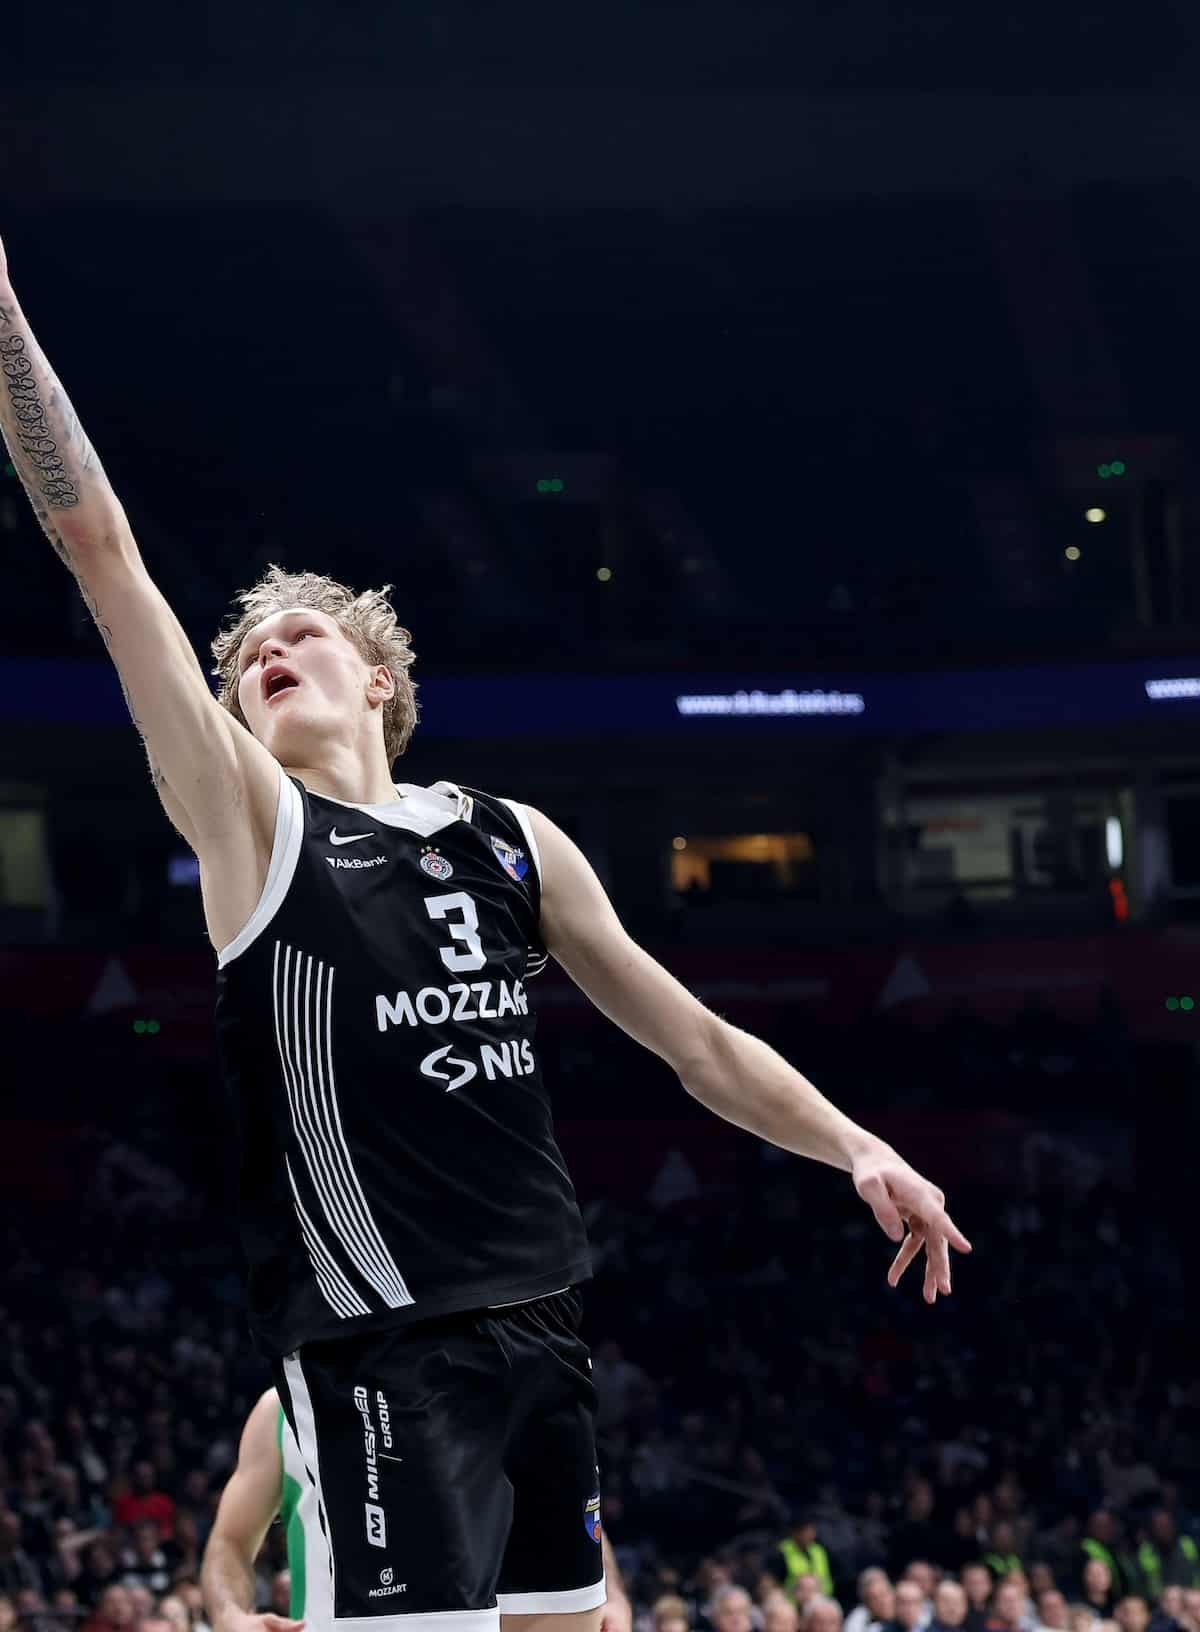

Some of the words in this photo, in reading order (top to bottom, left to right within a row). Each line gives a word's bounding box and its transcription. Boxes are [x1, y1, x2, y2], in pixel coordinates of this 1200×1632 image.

[423, 891, 488, 972] 3
[480, 1038, 535, 1081] NIS
[353, 1385, 380, 1501] MILSPED
[368, 1583, 408, 1598] MOZZART
